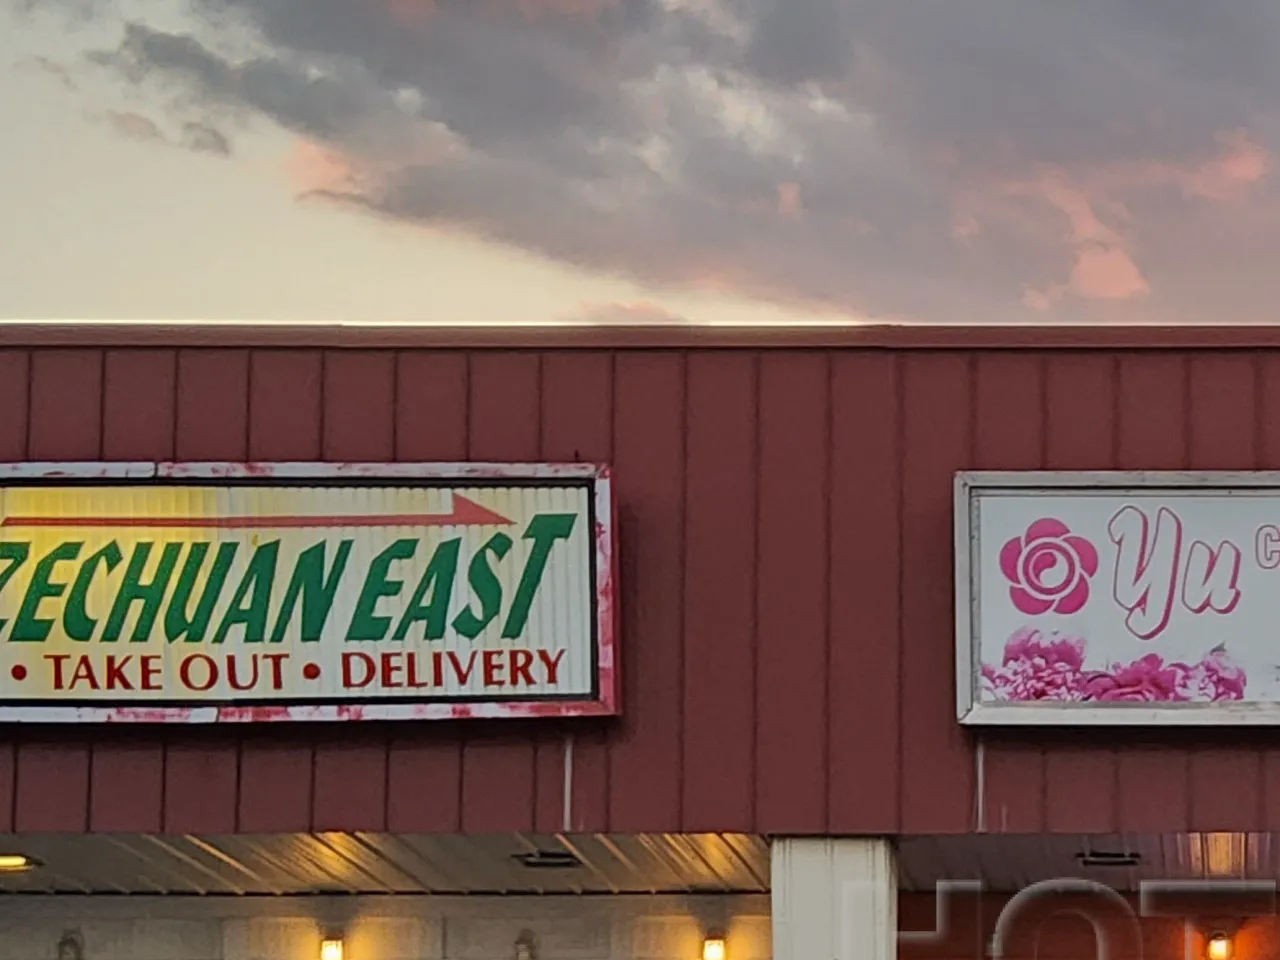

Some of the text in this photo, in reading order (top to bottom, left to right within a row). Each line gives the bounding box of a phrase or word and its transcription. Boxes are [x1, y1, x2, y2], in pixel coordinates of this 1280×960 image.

[345, 513, 578, 642] EAST
[1108, 505, 1241, 640] Yu
[44, 649, 565, 690] TAKE OUT DELIVERY
